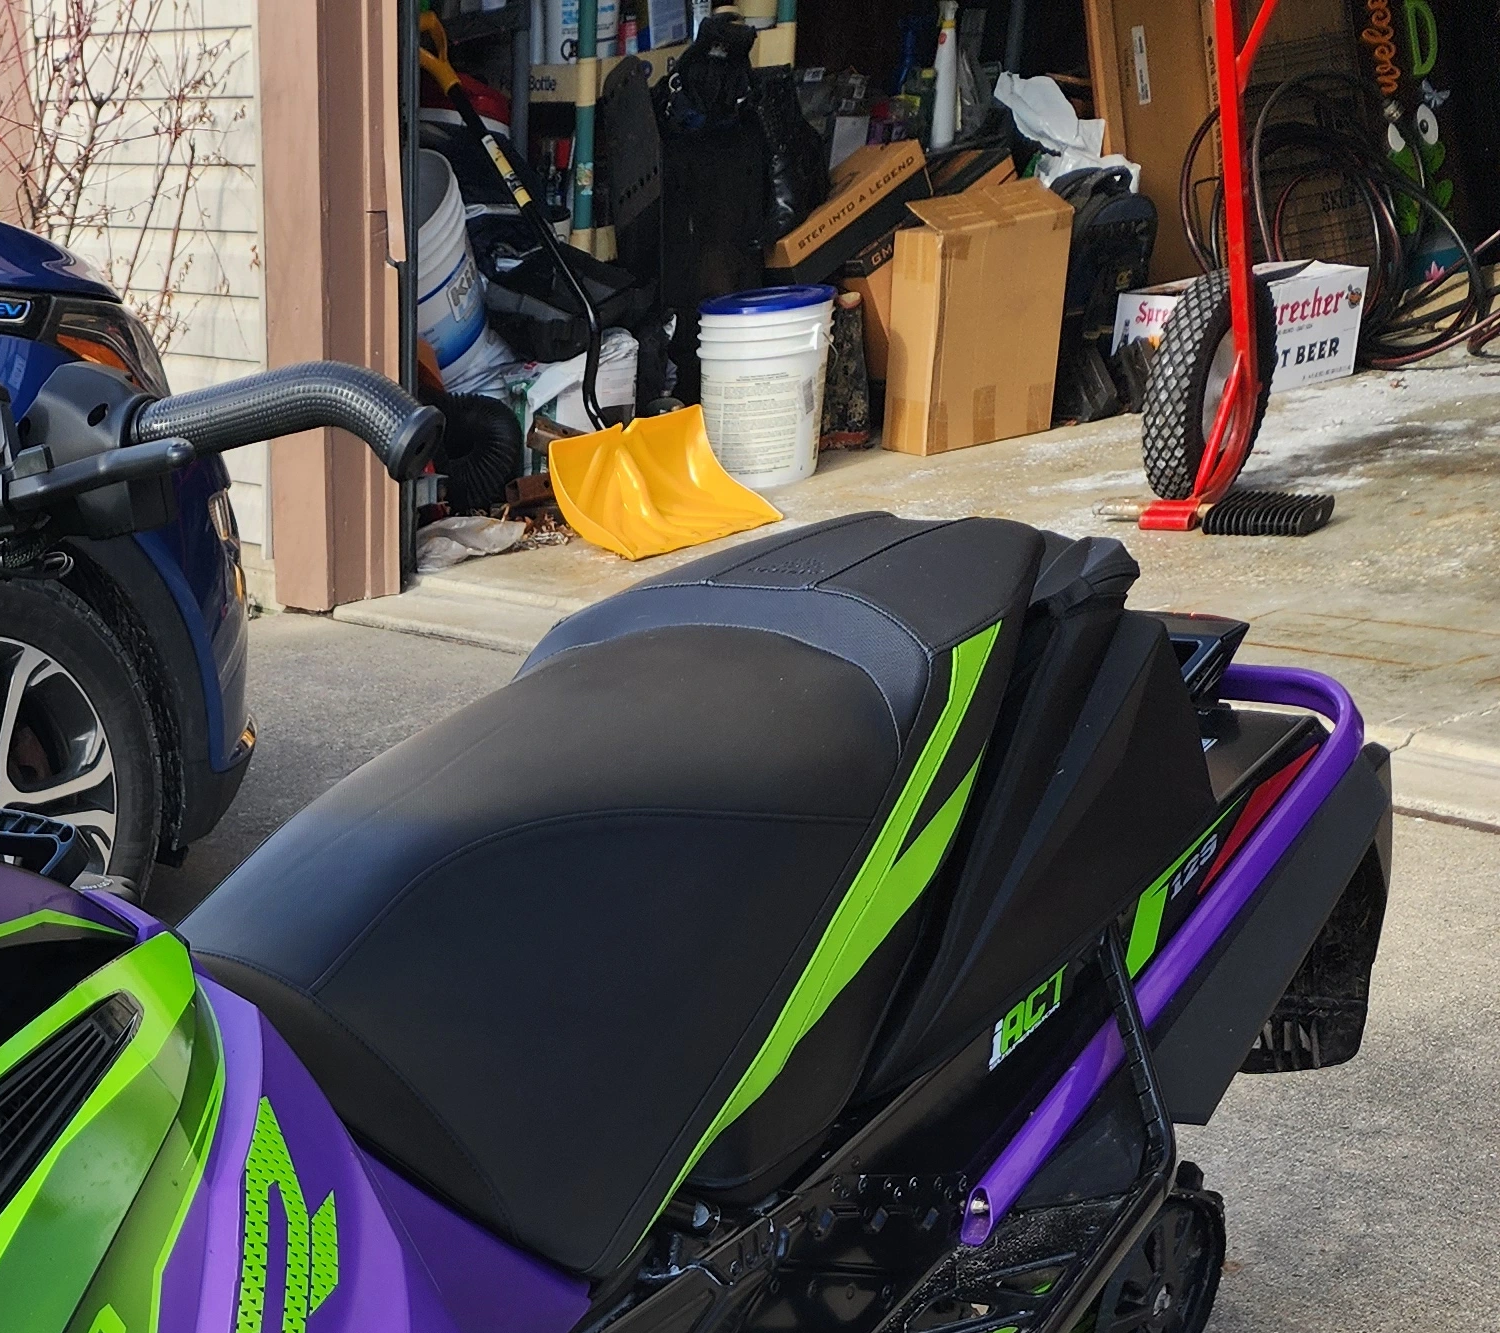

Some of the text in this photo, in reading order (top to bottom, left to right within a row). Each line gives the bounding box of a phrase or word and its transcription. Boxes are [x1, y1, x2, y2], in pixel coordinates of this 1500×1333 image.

[798, 156, 915, 250] STEP INTO A LEGEND
[1135, 301, 1170, 324] Spre
[1274, 286, 1345, 326] recher
[1294, 336, 1341, 366] BEER
